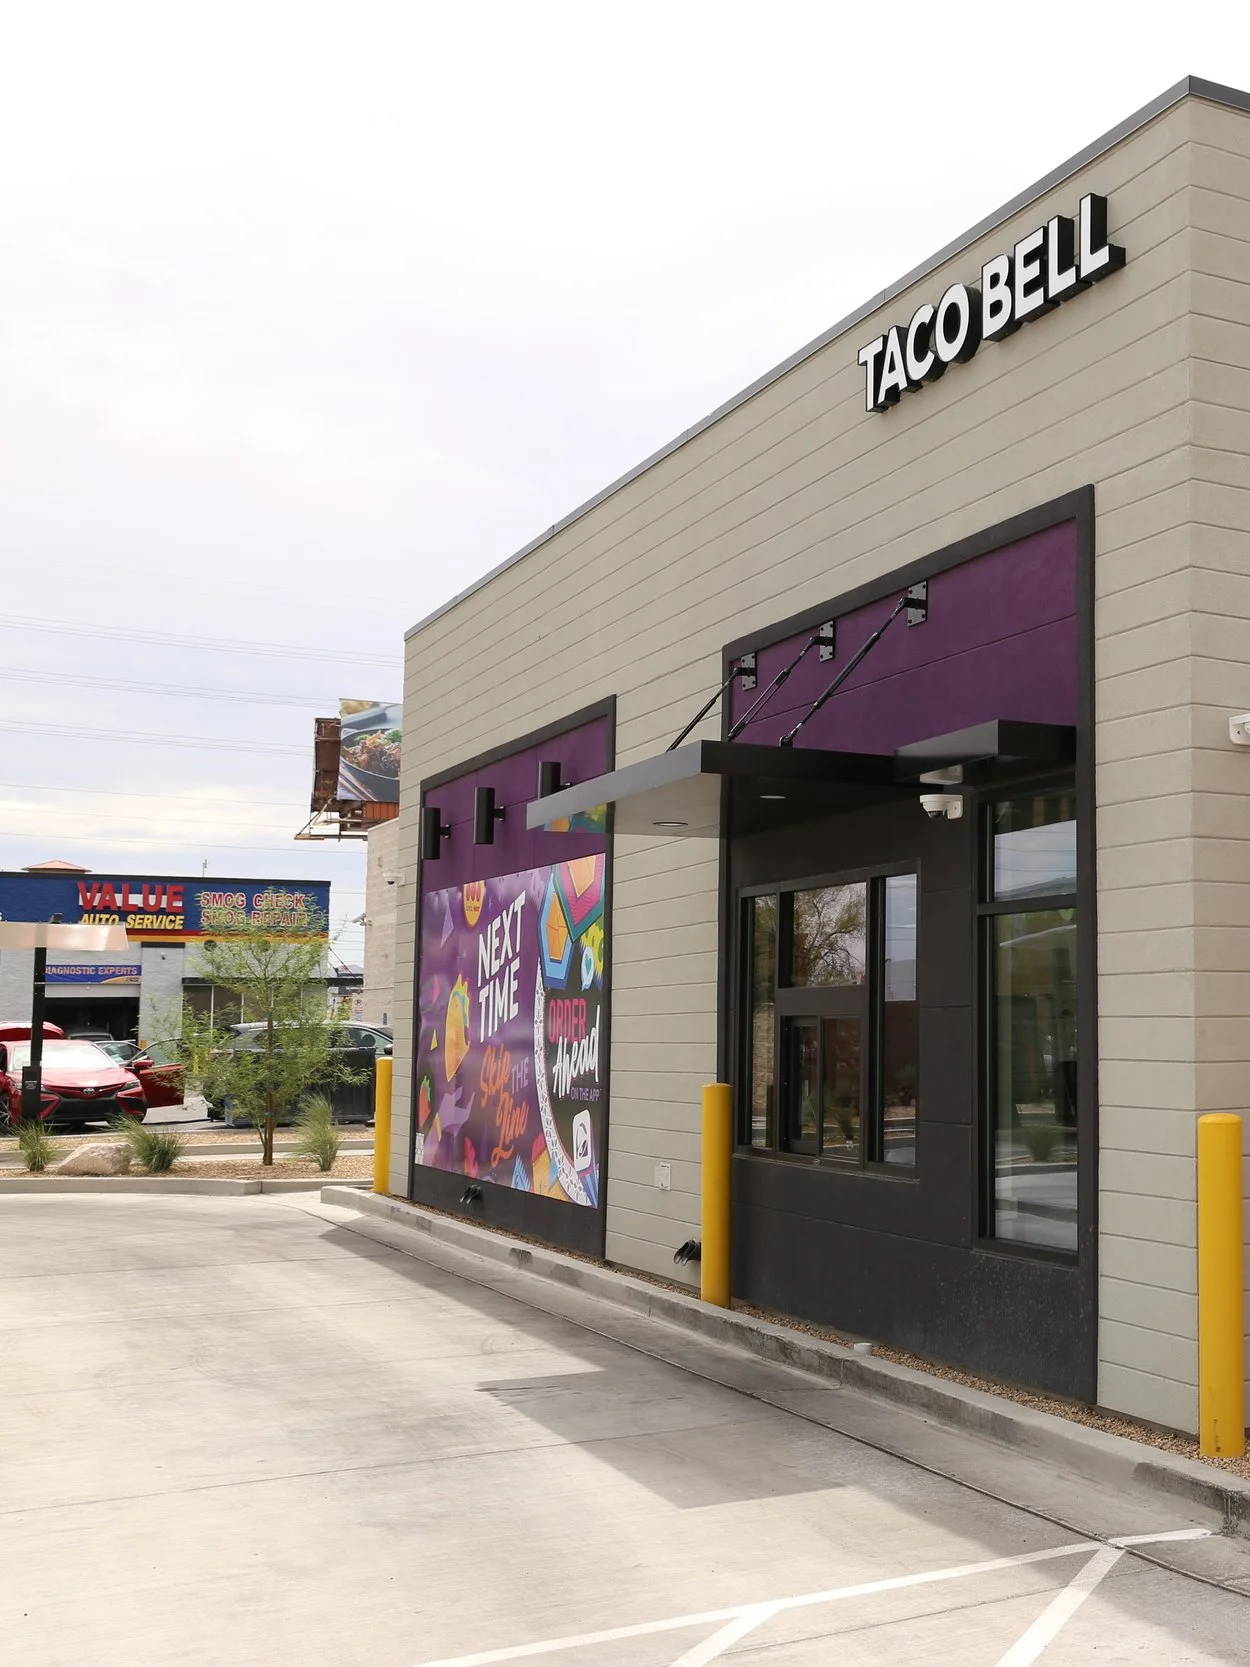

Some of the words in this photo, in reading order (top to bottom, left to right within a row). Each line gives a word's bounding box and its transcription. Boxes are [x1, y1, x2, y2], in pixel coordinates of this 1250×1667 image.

[858, 283, 973, 412] TACO
[981, 193, 1113, 340] BELL
[78, 880, 186, 913] VALUE
[81, 913, 120, 926] AUTO
[126, 914, 185, 930] SERVICE
[201, 891, 246, 908] SMOG
[253, 893, 305, 909] CHECK
[478, 890, 526, 987] NEXT
[45, 966, 96, 975] IAGNOSTIC
[100, 966, 138, 975] EXPERTS
[479, 956, 520, 1043] TIME
[548, 998, 587, 1044] ORDER
[480, 1042, 511, 1107] Skip
[511, 1056, 530, 1095] THE
[552, 1004, 600, 1099] Ahead
[570, 1087, 579, 1100] ON
[579, 1087, 589, 1101] THE
[589, 1088, 600, 1102] APP
[491, 1092, 530, 1168] Line
